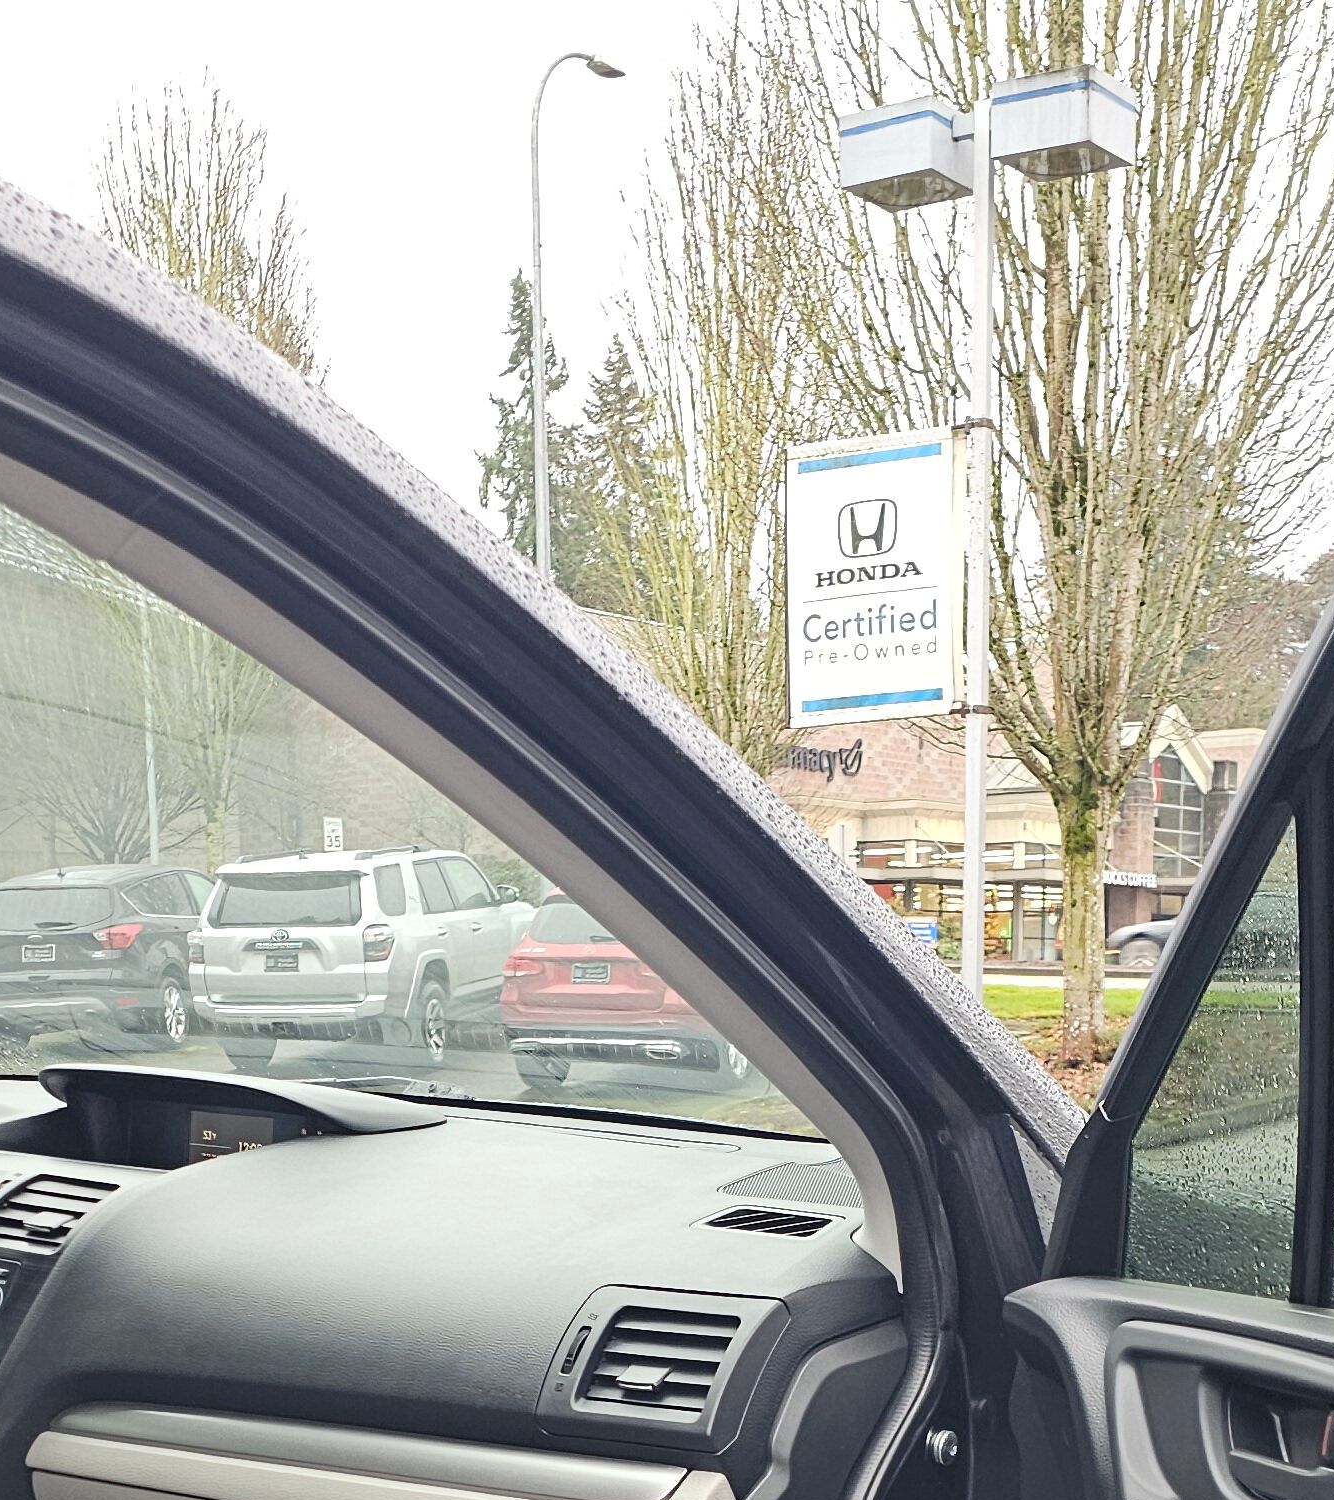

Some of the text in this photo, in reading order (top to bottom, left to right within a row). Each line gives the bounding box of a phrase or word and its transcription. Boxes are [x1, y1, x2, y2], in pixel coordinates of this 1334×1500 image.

[815, 561, 923, 588] HONDA
[803, 599, 937, 642] Certified
[804, 635, 937, 666] Pre-Owned
[327, 835, 341, 848] 35
